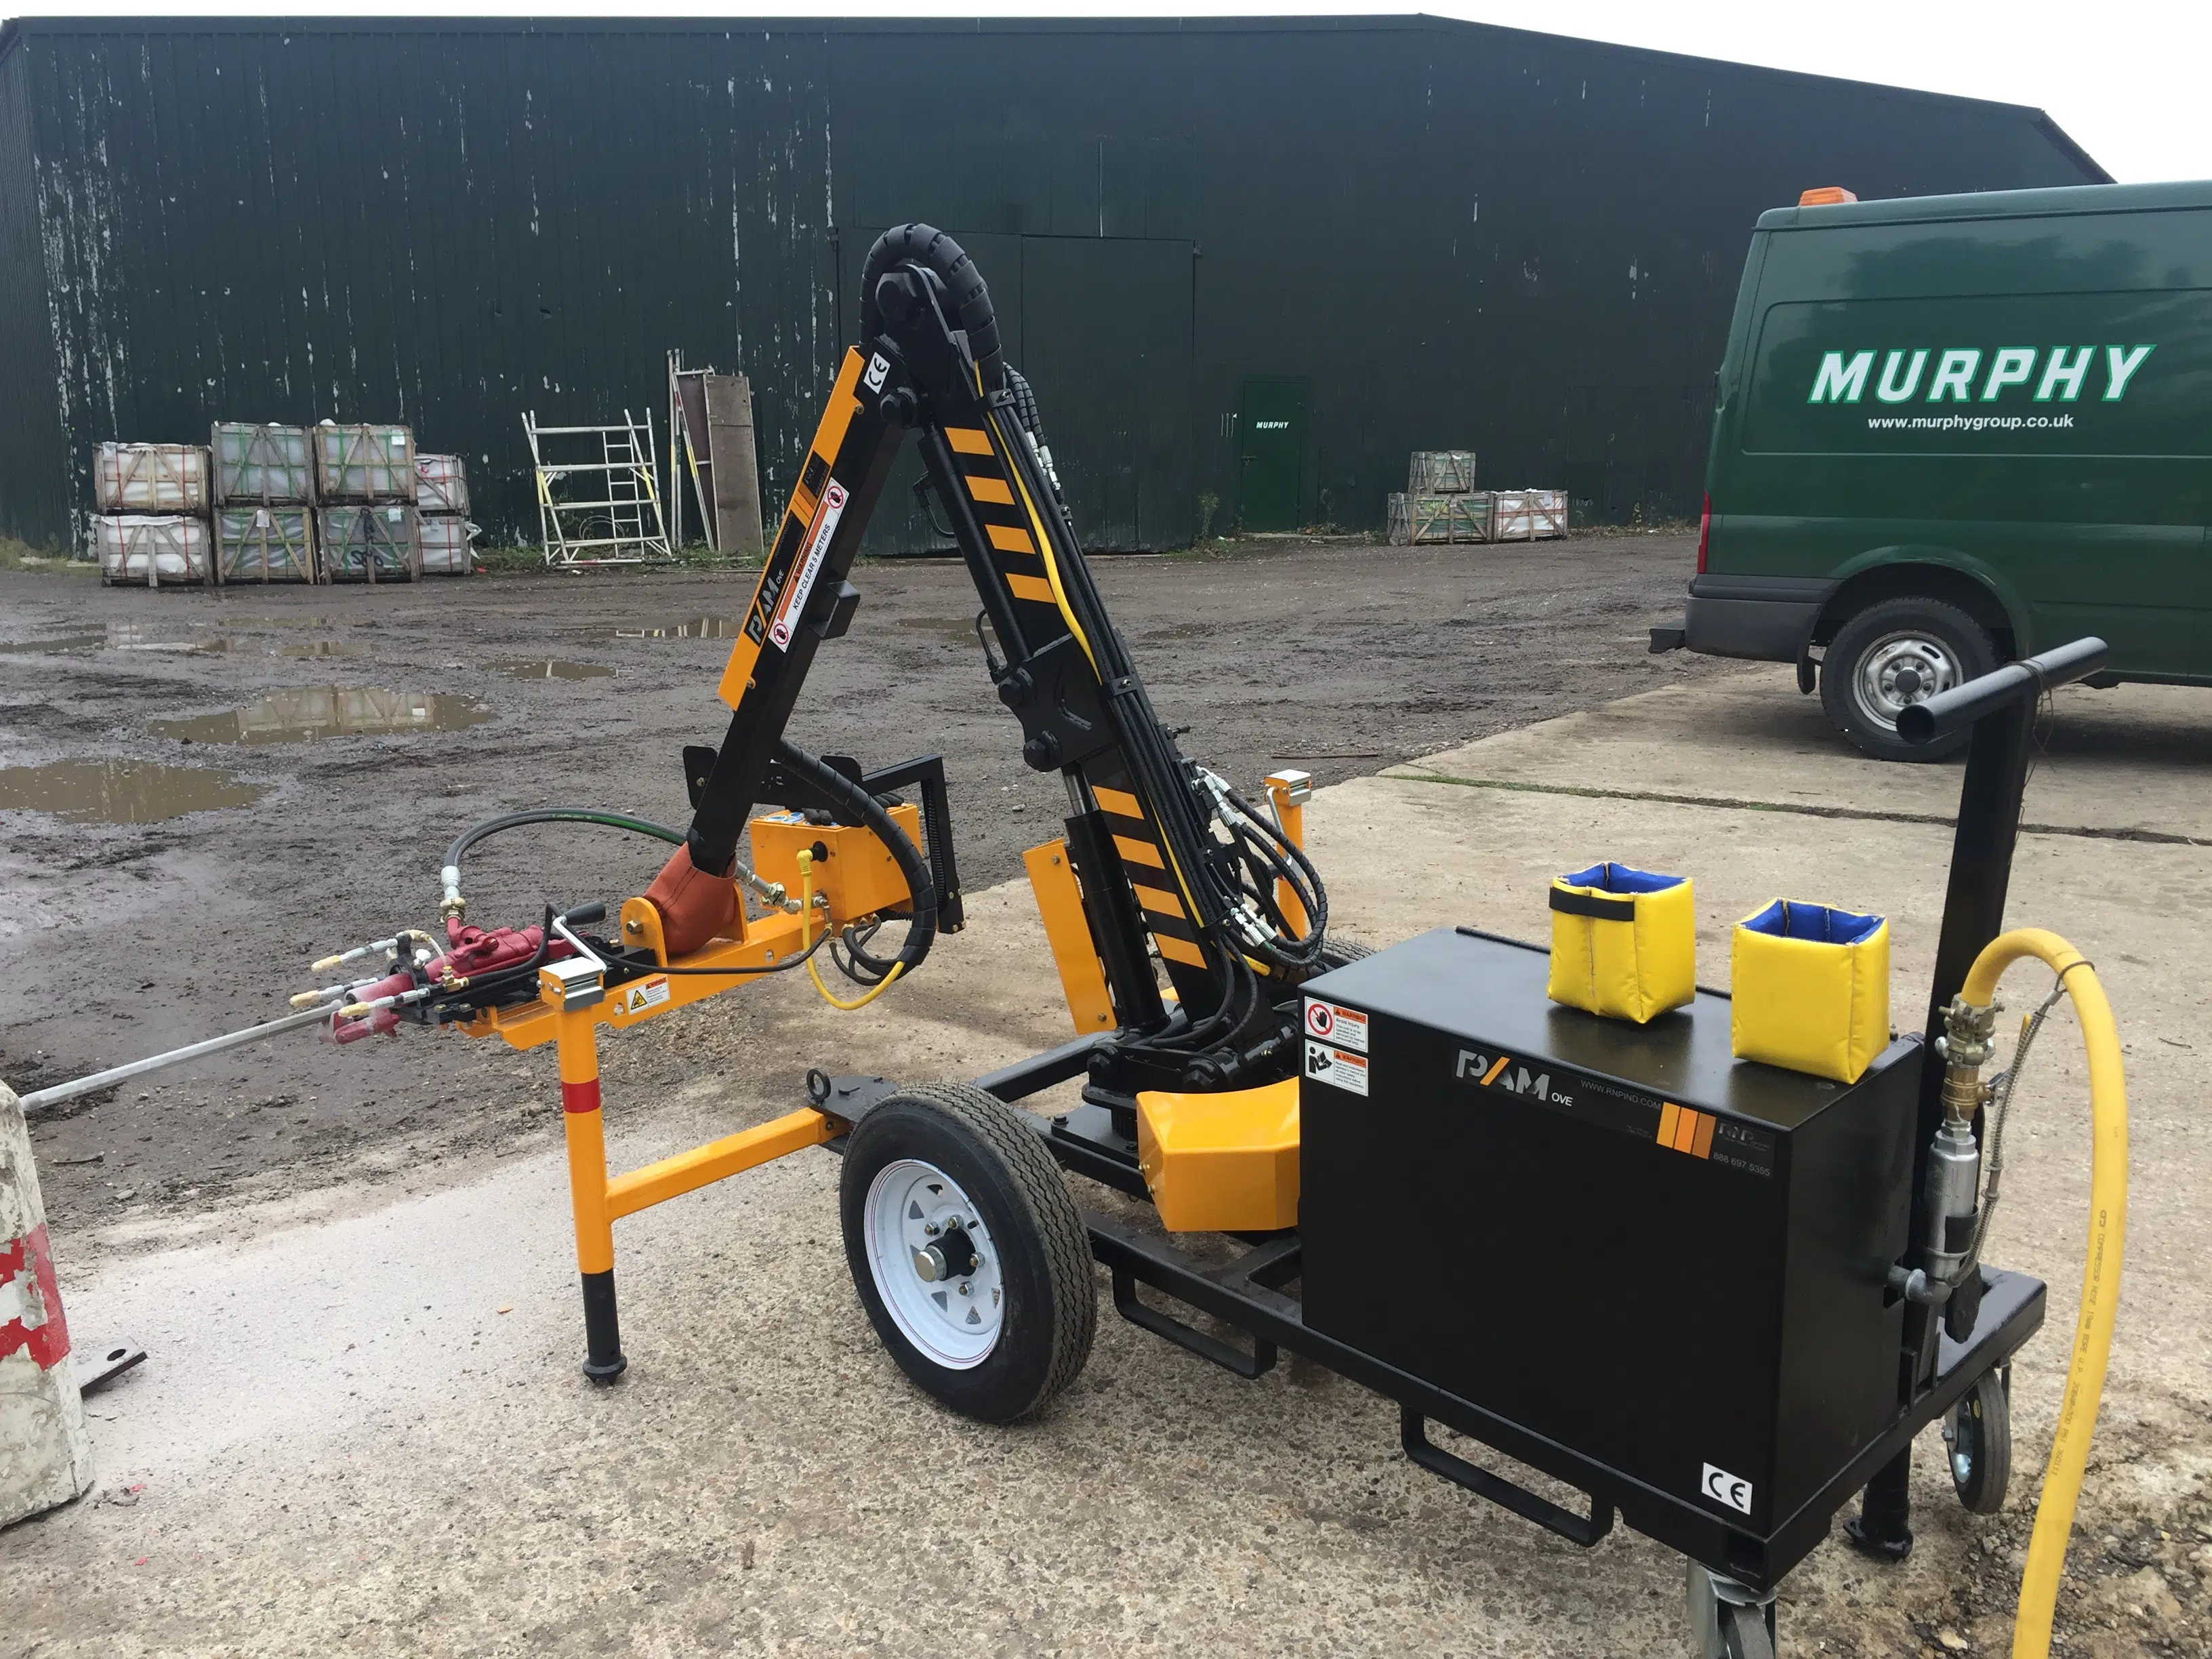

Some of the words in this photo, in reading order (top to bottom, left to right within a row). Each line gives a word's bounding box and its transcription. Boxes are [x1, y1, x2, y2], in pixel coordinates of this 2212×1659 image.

[868, 357, 887, 386] CE
[1807, 344, 2158, 403] MURPHY
[1256, 421, 1289, 429] MURPHY
[1868, 413, 2074, 430] www.murphygroup.co.uk
[792, 588, 804, 611] KEEP
[801, 562, 815, 589] CLEAR
[817, 523, 831, 557] METERS
[796, 543, 813, 575] WARNING
[1551, 1092, 1574, 1107] OVE
[1713, 1152, 1729, 1164] 888
[1731, 1158, 1747, 1168] 697
[2093, 1233, 2105, 1282] COMPRESSOR
[2089, 1285, 2099, 1306] HOSE
[1708, 1472, 1746, 1509] CE
